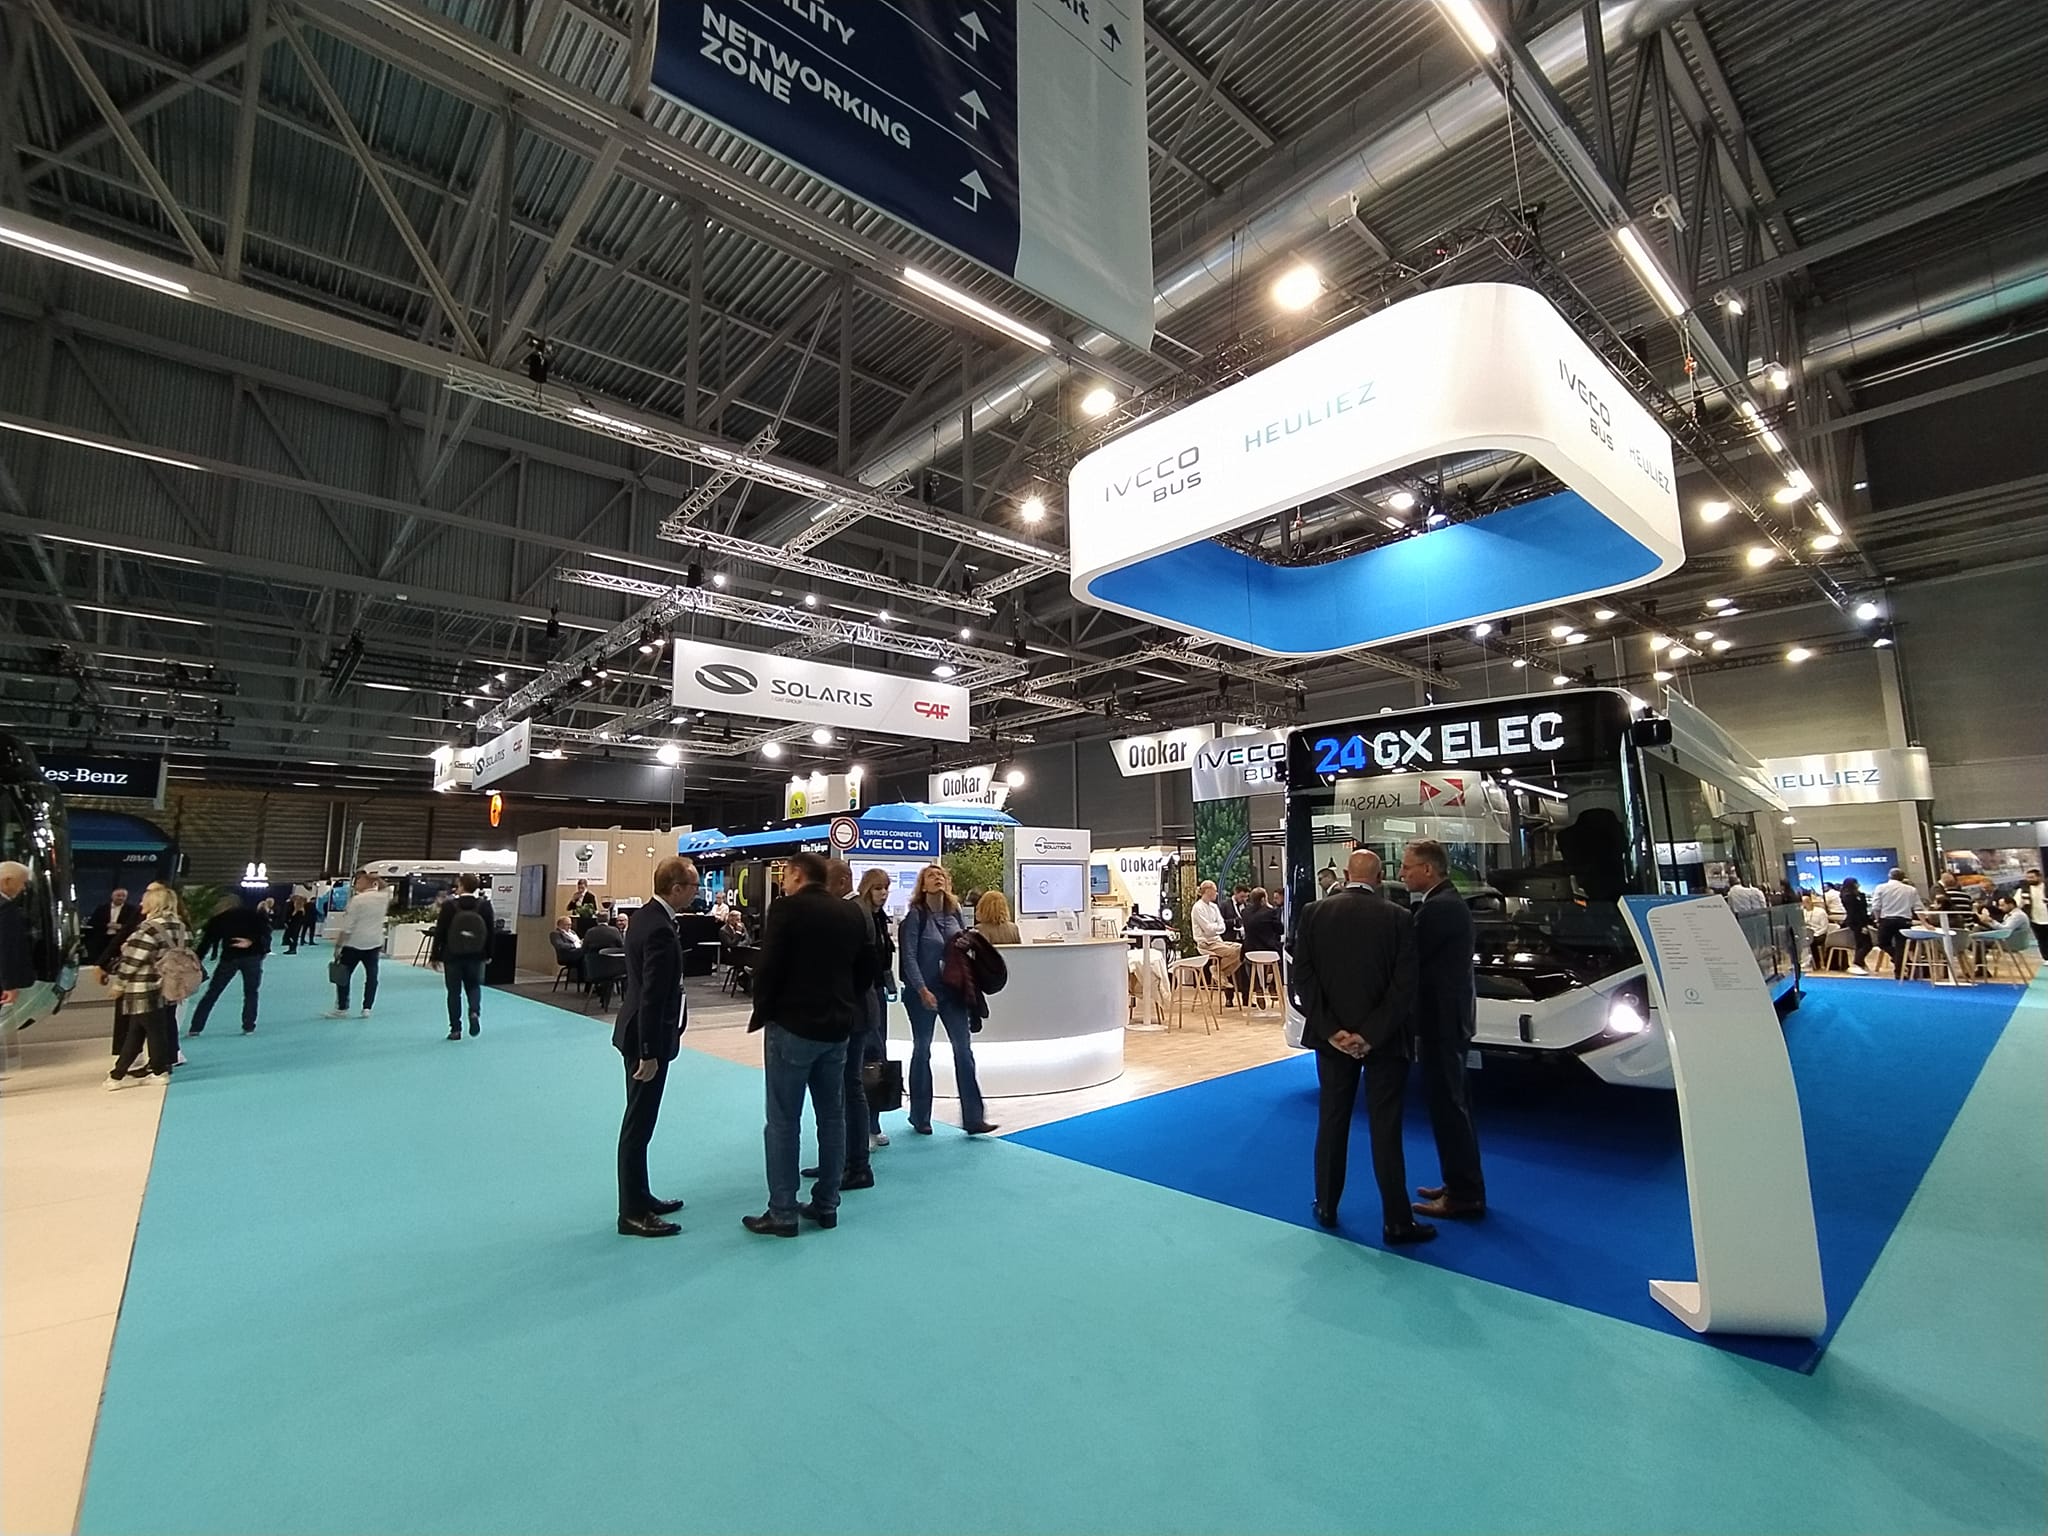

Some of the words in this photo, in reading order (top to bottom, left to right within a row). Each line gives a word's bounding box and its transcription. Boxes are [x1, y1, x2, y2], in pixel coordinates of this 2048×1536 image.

[783, 0, 855, 45] LITY
[700, 31, 792, 104] ZONE
[703, 3, 911, 149] NETWORKING
[1559, 359, 1611, 427] IVECO
[1245, 380, 1376, 452] HEULIEZ
[1589, 418, 1614, 451] BUS
[1152, 471, 1202, 503] BUS
[771, 679, 873, 708] SOLARIS
[914, 701, 950, 720] CAF
[1128, 740, 1188, 769] Otokar
[1199, 743, 1286, 769] IVECO
[1314, 735, 1367, 774] 24
[1373, 726, 1433, 767] GX
[1440, 711, 1566, 763] ELEC
[40, 766, 129, 785] es-Benz
[943, 775, 981, 797] Otokar
[856, 838, 905, 850] IVECO
[907, 840, 930, 851] ON
[944, 824, 969, 839] Urbino
[969, 825, 979, 840] 12
[1120, 856, 1163, 873] Otokar
